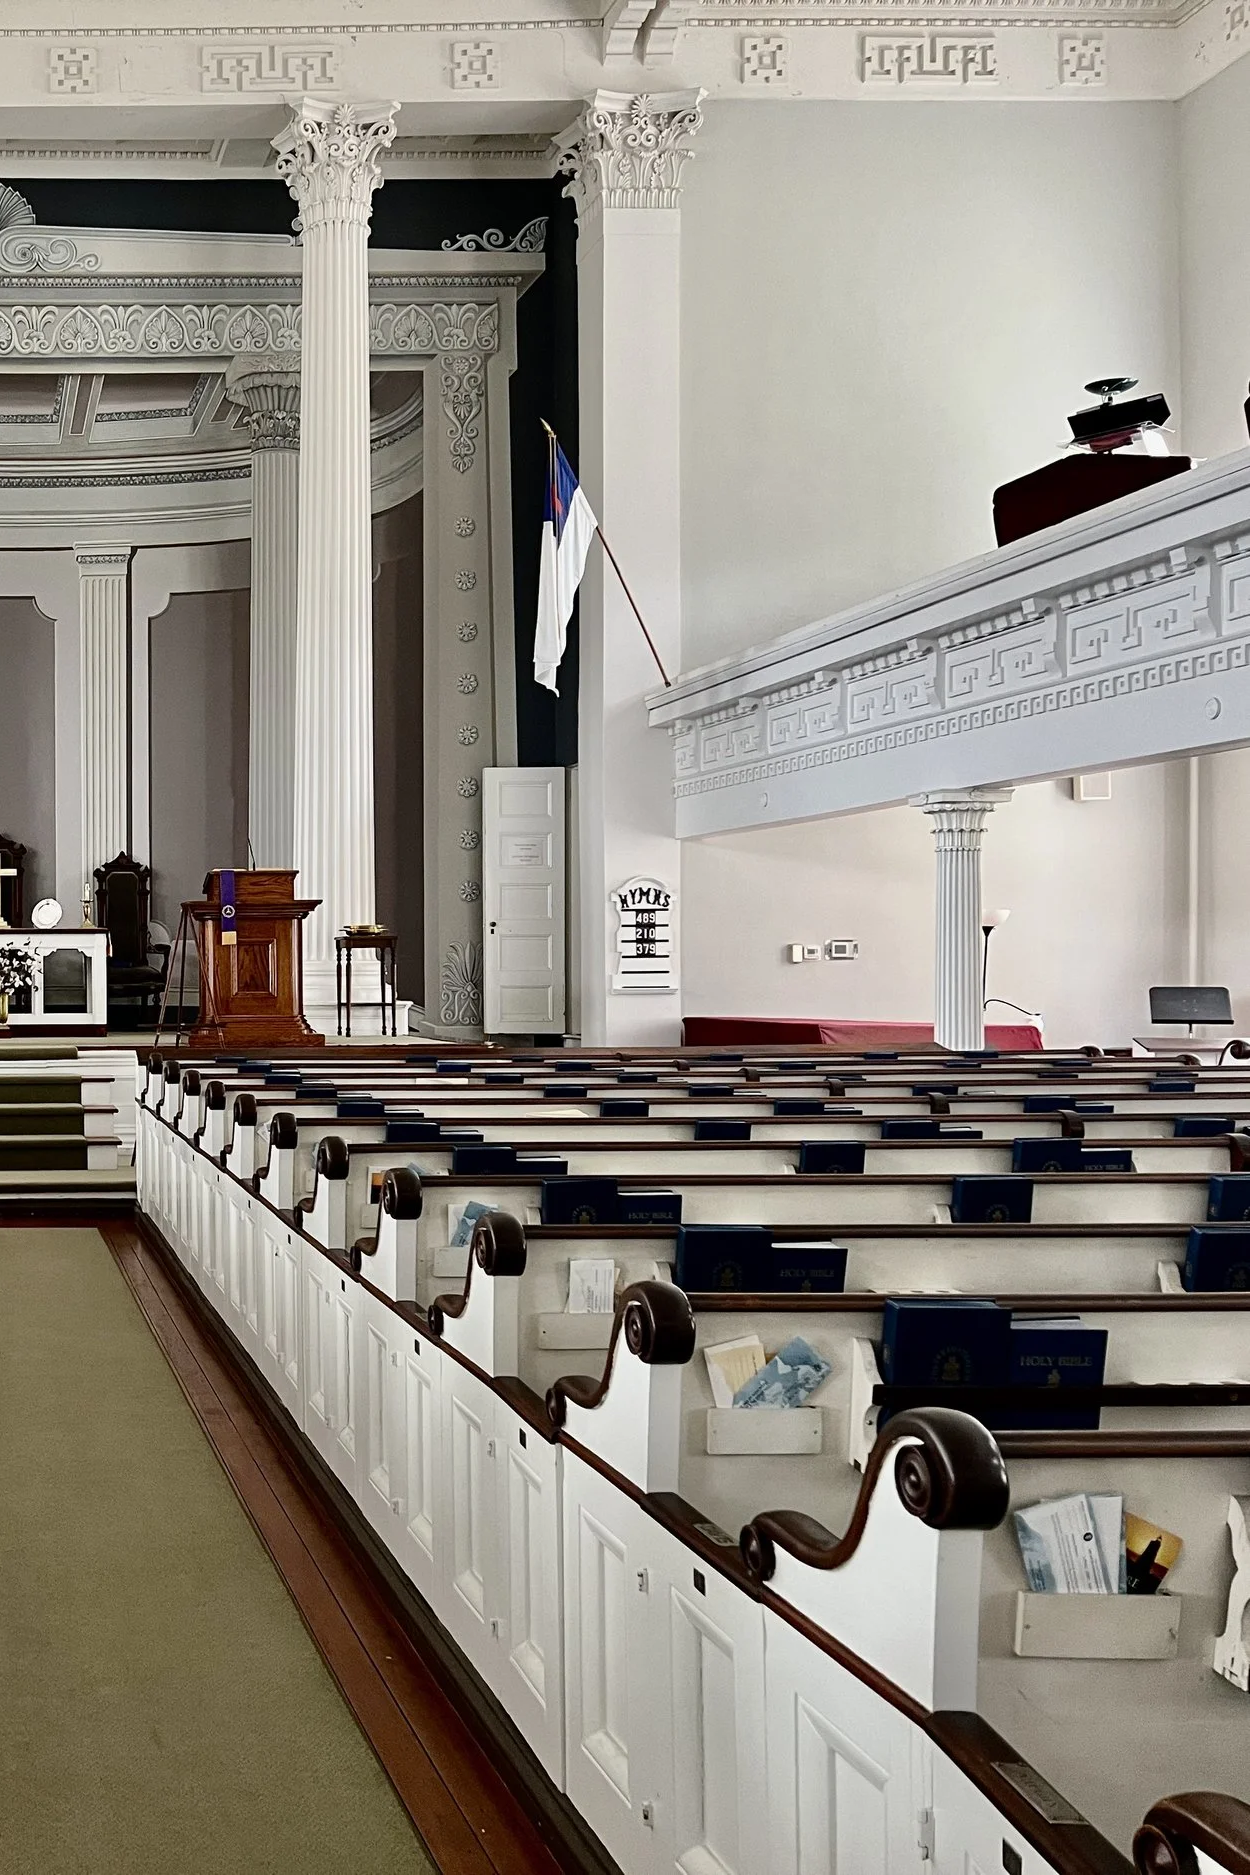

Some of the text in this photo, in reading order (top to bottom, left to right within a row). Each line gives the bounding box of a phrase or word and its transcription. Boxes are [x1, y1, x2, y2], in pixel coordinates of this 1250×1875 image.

[618, 887, 671, 908] HYMNS
[636, 912, 656, 924] 489
[636, 928, 656, 939] 210
[636, 943, 656, 954] 379
[779, 1268, 806, 1278] HOLY
[1020, 1355, 1093, 1367] HOLY BIBLE
